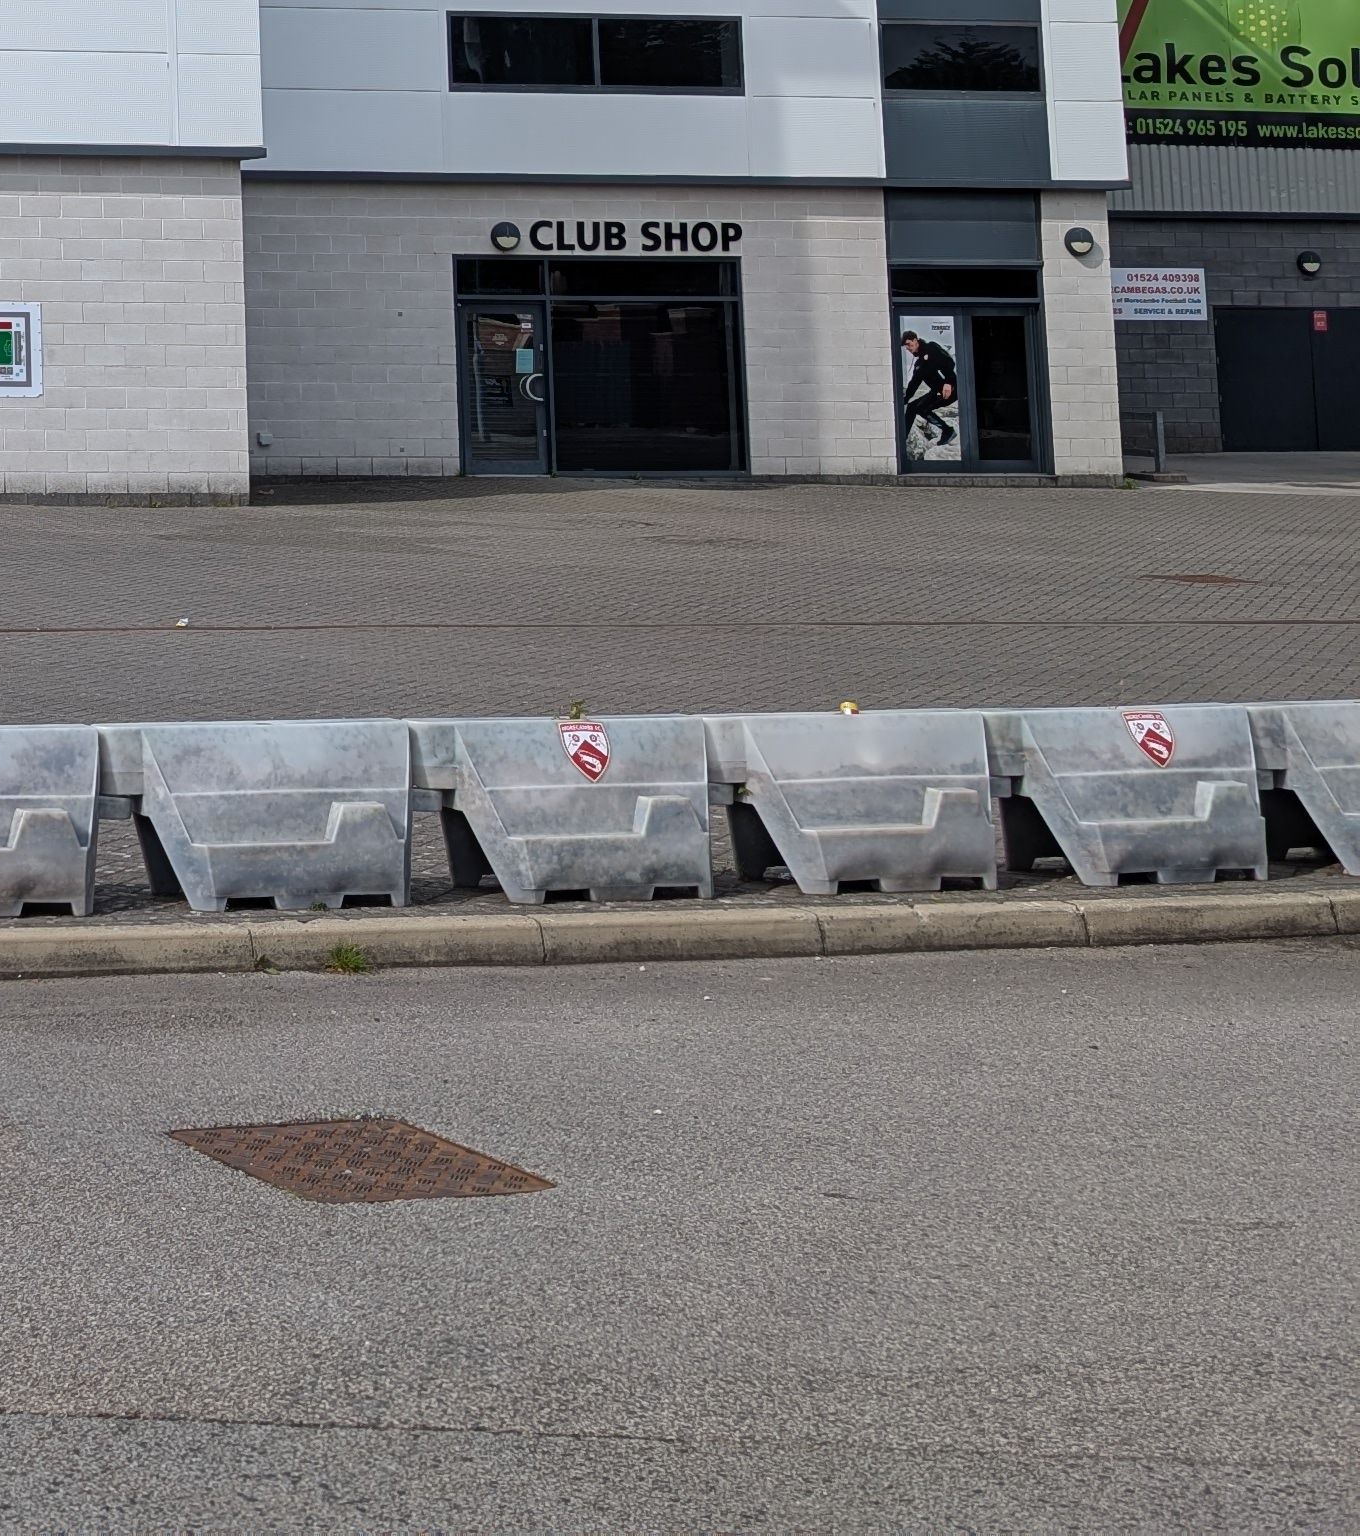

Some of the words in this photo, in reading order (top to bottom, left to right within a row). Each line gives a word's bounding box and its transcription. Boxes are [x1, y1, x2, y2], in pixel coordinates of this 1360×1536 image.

[1122, 43, 1261, 87] akes
[1169, 91, 1234, 103] PANELS
[1244, 93, 1254, 104] &
[1264, 93, 1342, 106] BATTERY
[1136, 118, 1183, 136] 01524
[1187, 120, 1216, 136] 965
[1219, 121, 1248, 137] 195
[529, 220, 627, 252] CLUB
[641, 221, 743, 252] SHOP
[1127, 273, 1159, 282] 01524
[1162, 273, 1200, 282] 409398
[1133, 307, 1166, 315] SERVICE
